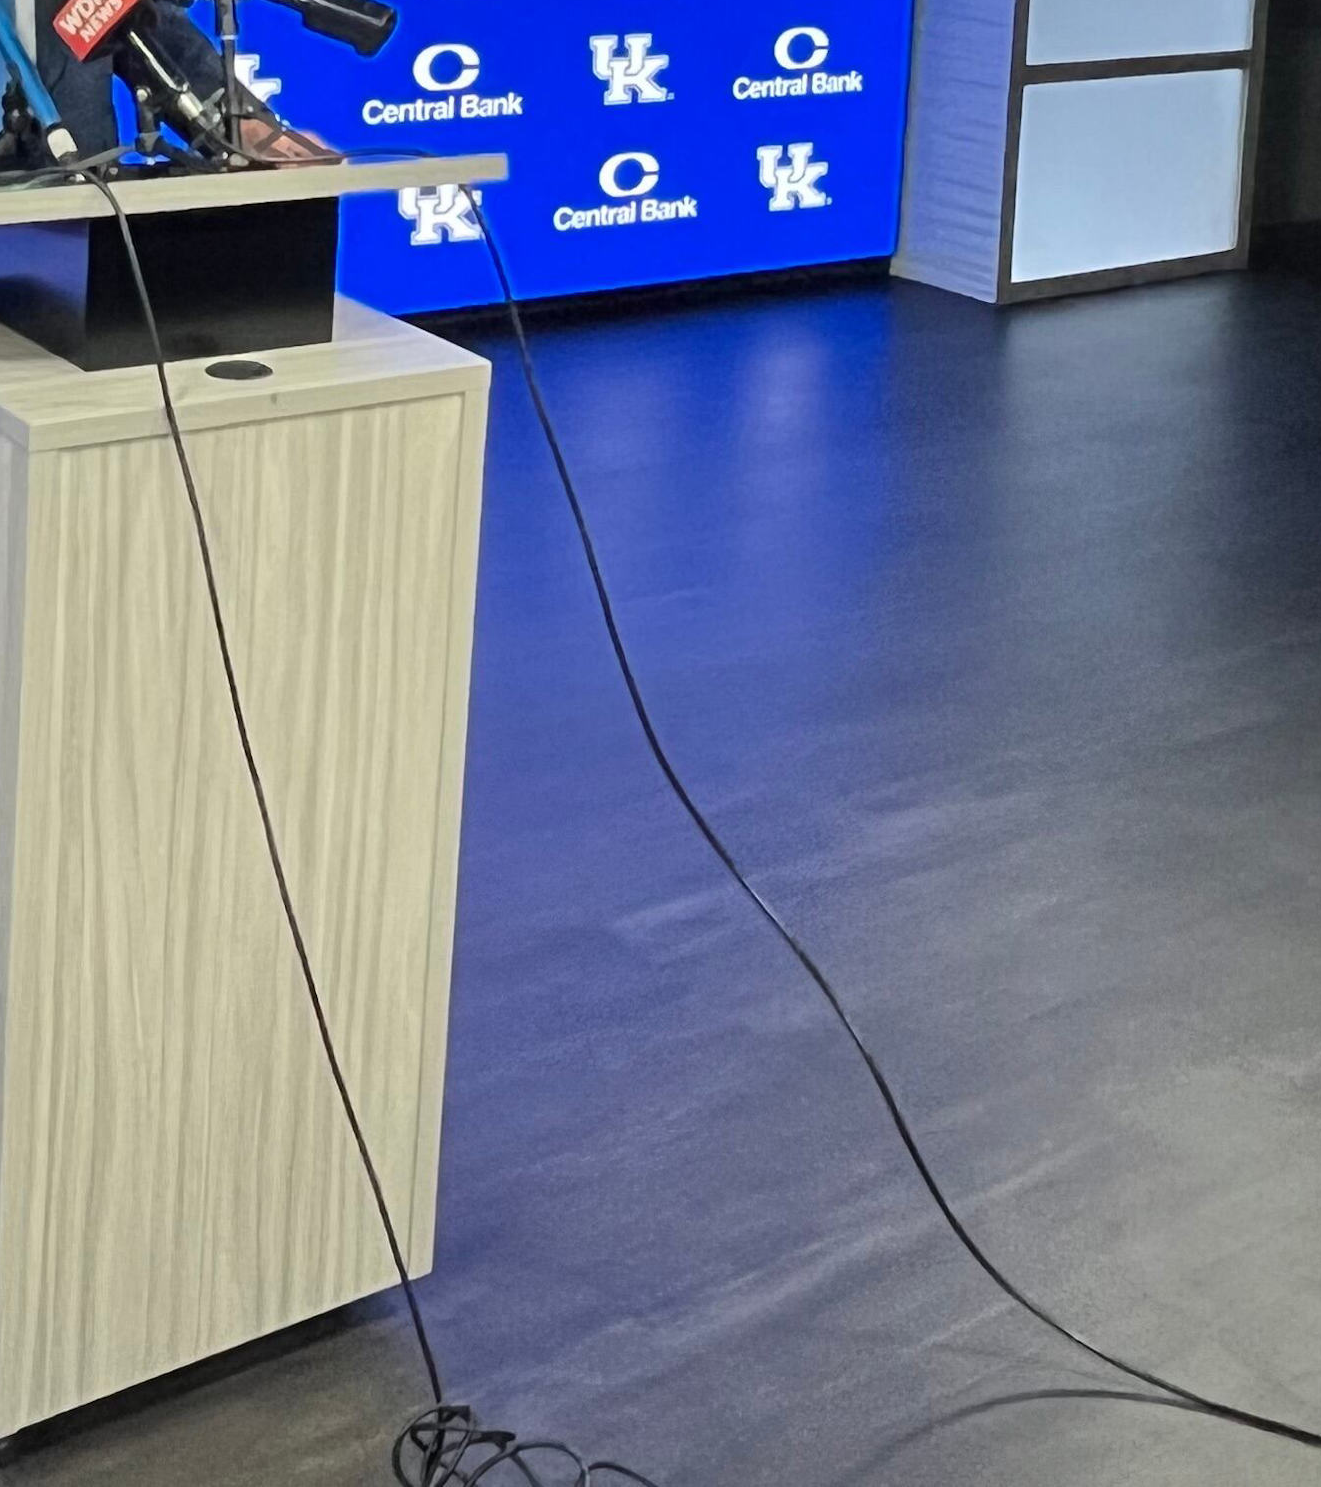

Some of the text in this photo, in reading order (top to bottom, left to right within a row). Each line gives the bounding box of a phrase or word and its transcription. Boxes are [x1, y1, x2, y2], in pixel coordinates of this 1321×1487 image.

[732, 70, 863, 100] Central Bank
[361, 91, 523, 125] Central Bank
[553, 195, 698, 232] Central Bank
